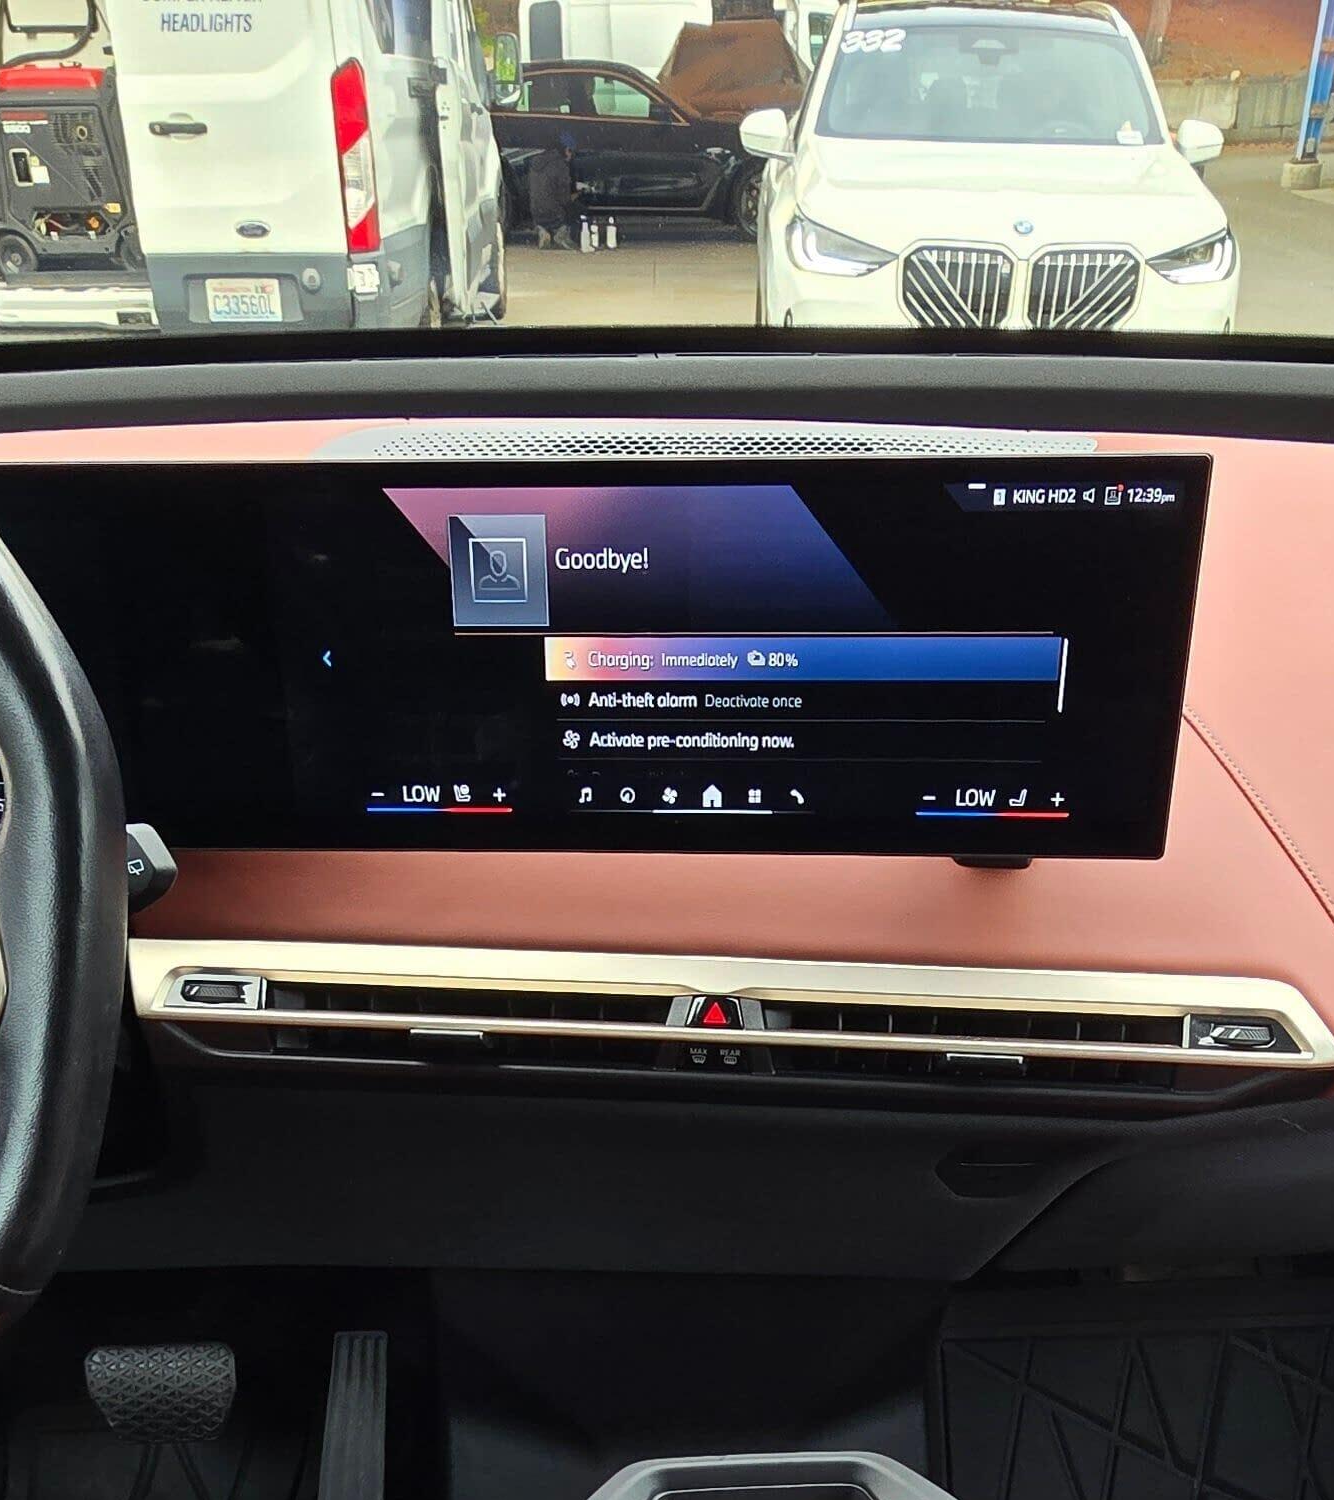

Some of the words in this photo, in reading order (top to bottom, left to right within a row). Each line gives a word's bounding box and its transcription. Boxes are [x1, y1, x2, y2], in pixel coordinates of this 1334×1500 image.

[161, 13, 252, 32] HEADLIGHTS
[840, 28, 906, 54] 332
[1013, 489, 1045, 504] KING
[1048, 488, 1076, 504] HD2
[554, 547, 649, 573] Goodbye!
[587, 651, 655, 670] Charging:
[661, 652, 739, 669] Immediately
[768, 652, 799, 668] 80%
[588, 692, 655, 708] Anti-theft
[657, 692, 698, 708] alarm
[704, 693, 769, 708] Deactivate
[772, 696, 803, 708] once
[589, 731, 645, 748] Activate
[647, 731, 759, 750] pre-conditioning
[761, 735, 795, 748] now.
[402, 785, 440, 802] LOW
[955, 788, 997, 807] LOW
[690, 1047, 708, 1055] MAX
